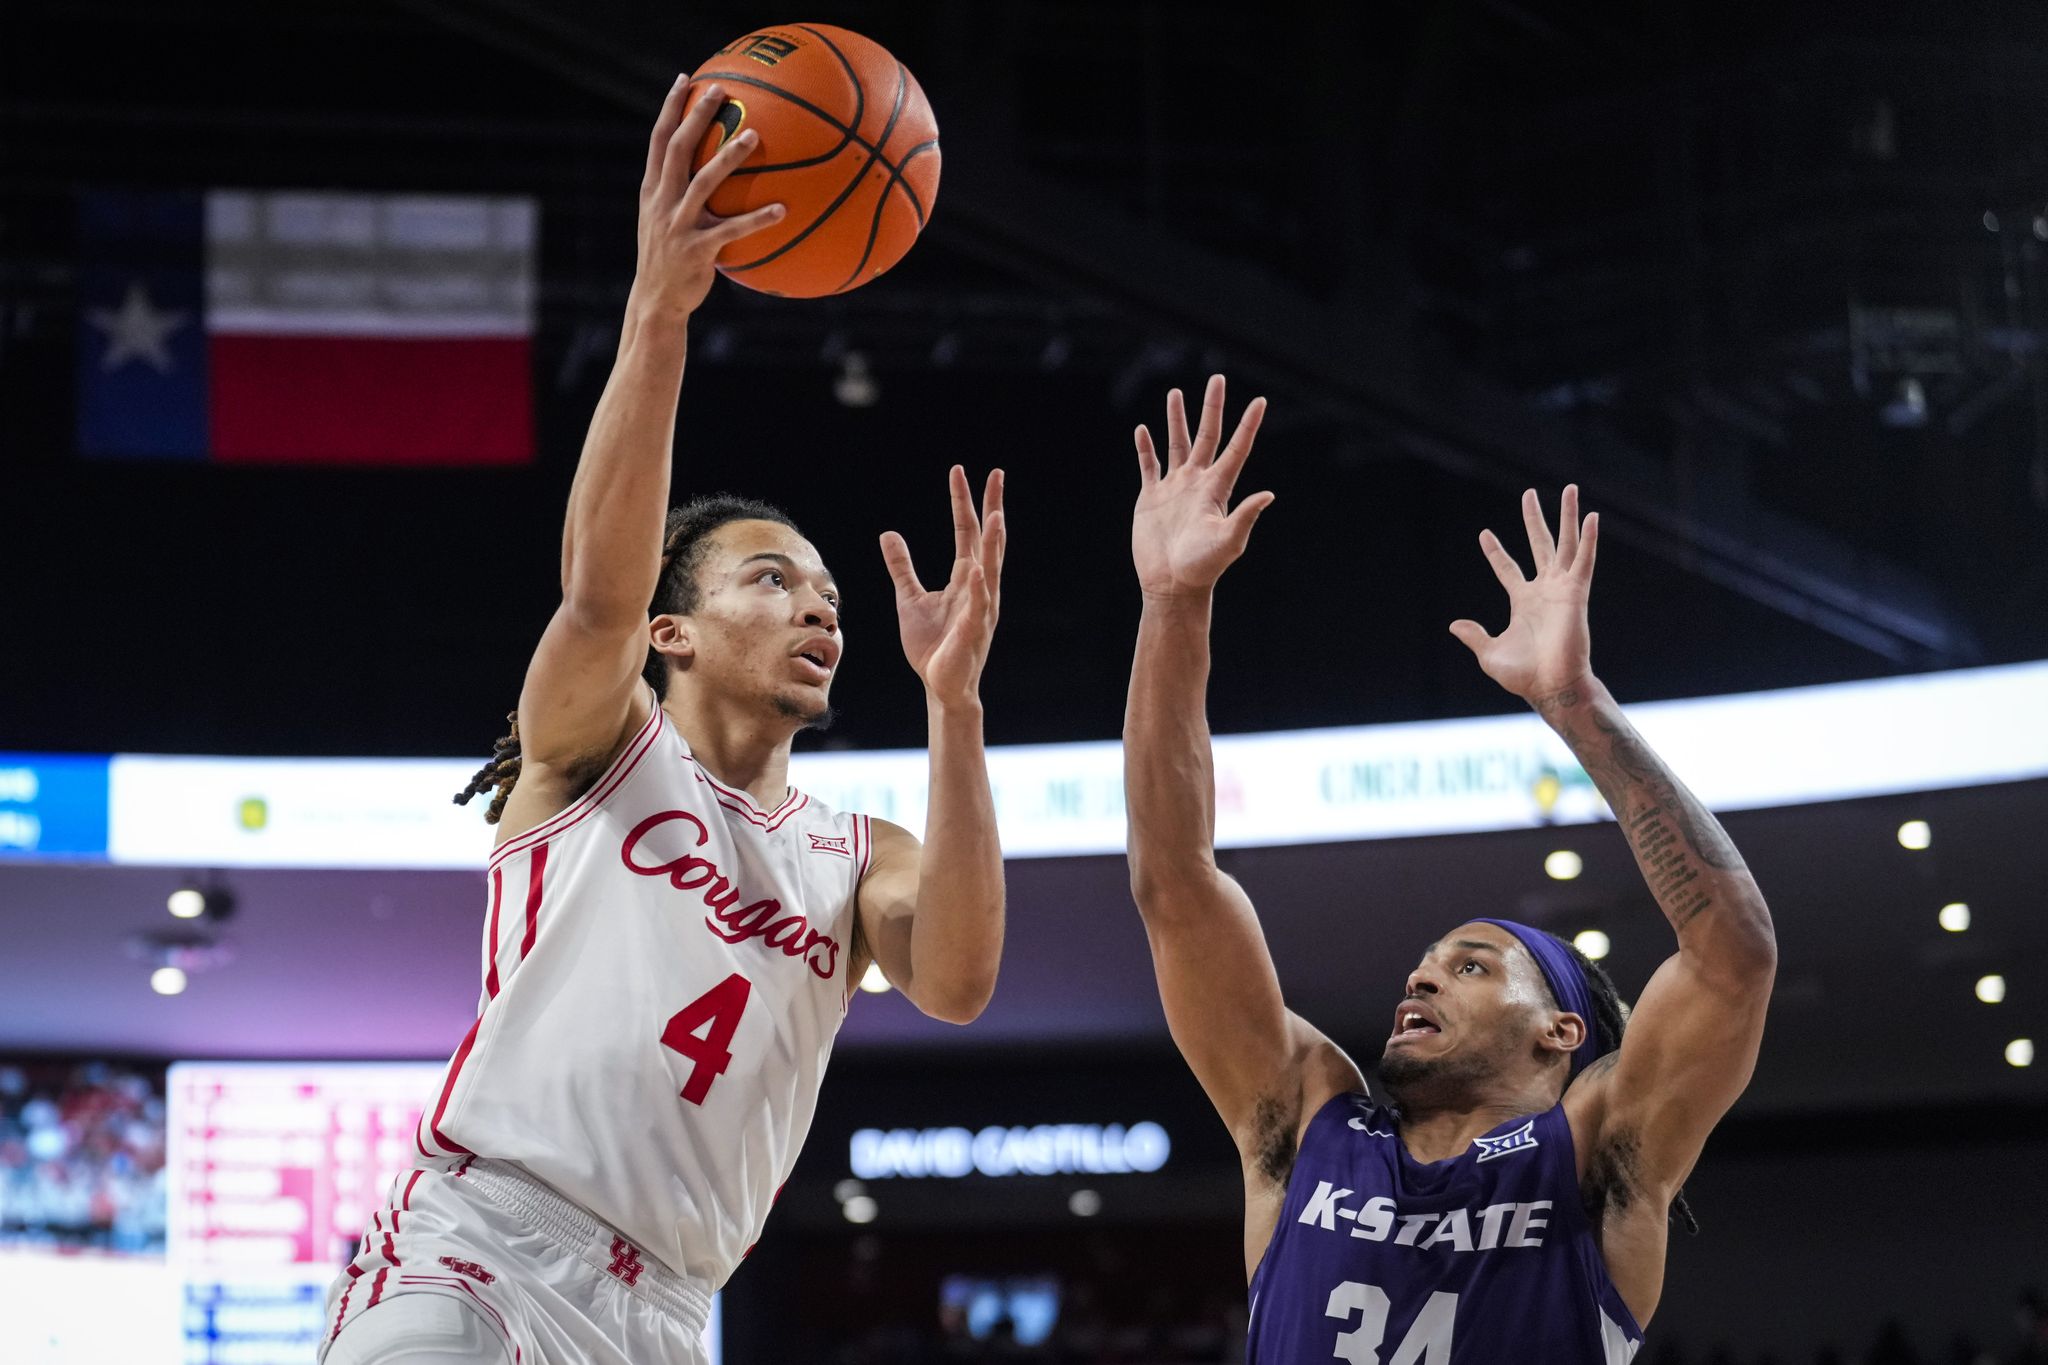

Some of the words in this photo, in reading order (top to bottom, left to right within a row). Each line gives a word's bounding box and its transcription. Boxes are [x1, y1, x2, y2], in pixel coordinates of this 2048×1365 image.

[622, 810, 840, 979] Cougars
[660, 972, 752, 1106] 4
[1473, 1120, 1539, 1163] XII
[1298, 1181, 1553, 1252] K-STATE
[1325, 1281, 1459, 1365] 34
